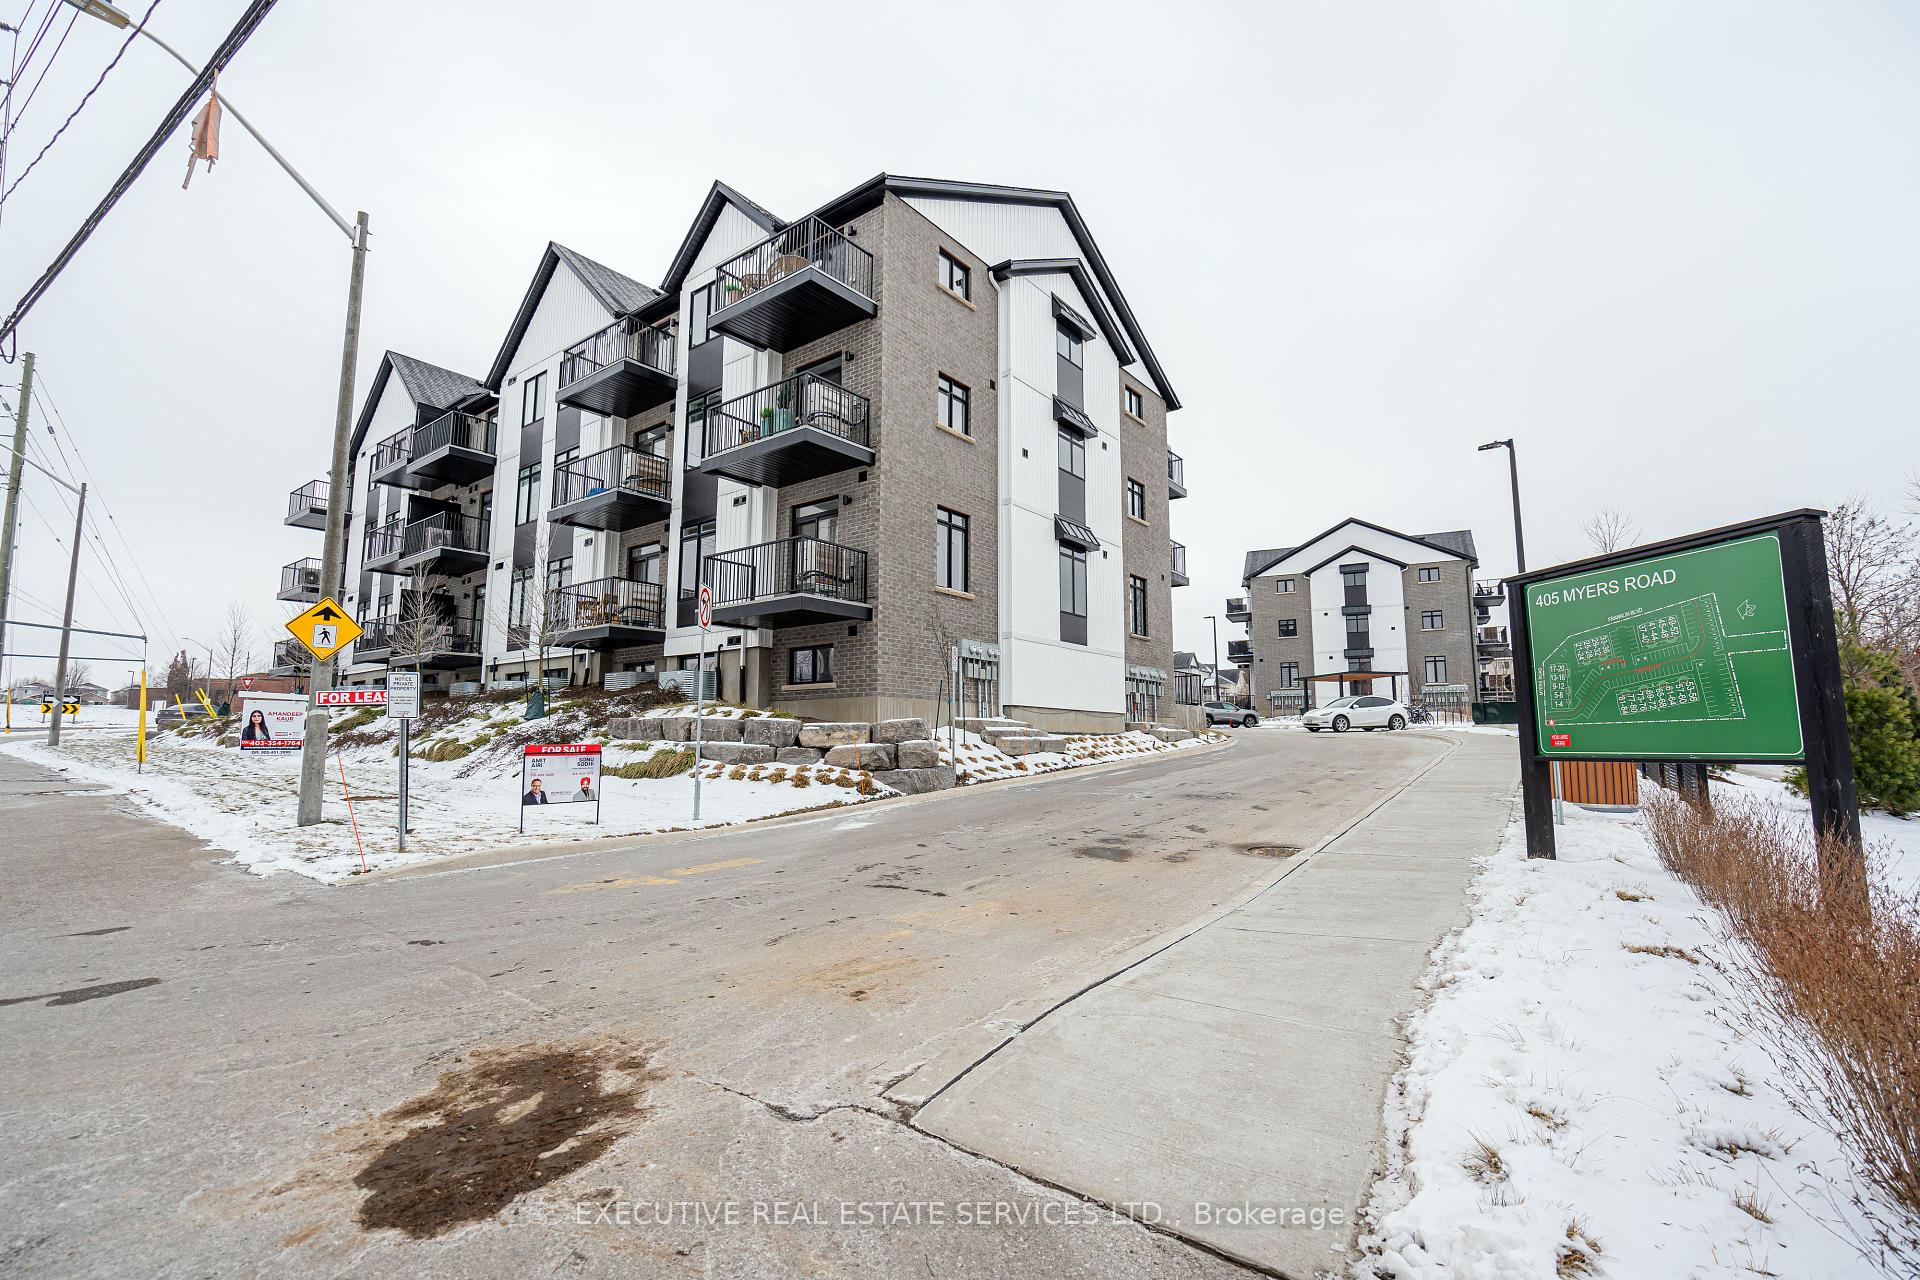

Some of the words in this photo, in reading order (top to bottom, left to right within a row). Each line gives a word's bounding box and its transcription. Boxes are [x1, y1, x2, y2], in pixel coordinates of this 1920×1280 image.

[1535, 591, 1560, 607] 405
[1563, 580, 1620, 602] MYERS
[1624, 569, 1677, 592] ROAD
[1607, 611, 1630, 622] FRANKLIN
[1550, 664, 1565, 672] 17-20
[1551, 673, 1566, 681] 13-16
[1552, 682, 1565, 690] 9-12
[319, 692, 352, 704] FOR
[355, 691, 388, 703] LEAS
[1554, 691, 1564, 699] 5-8
[1554, 700, 1563, 708] 1-4
